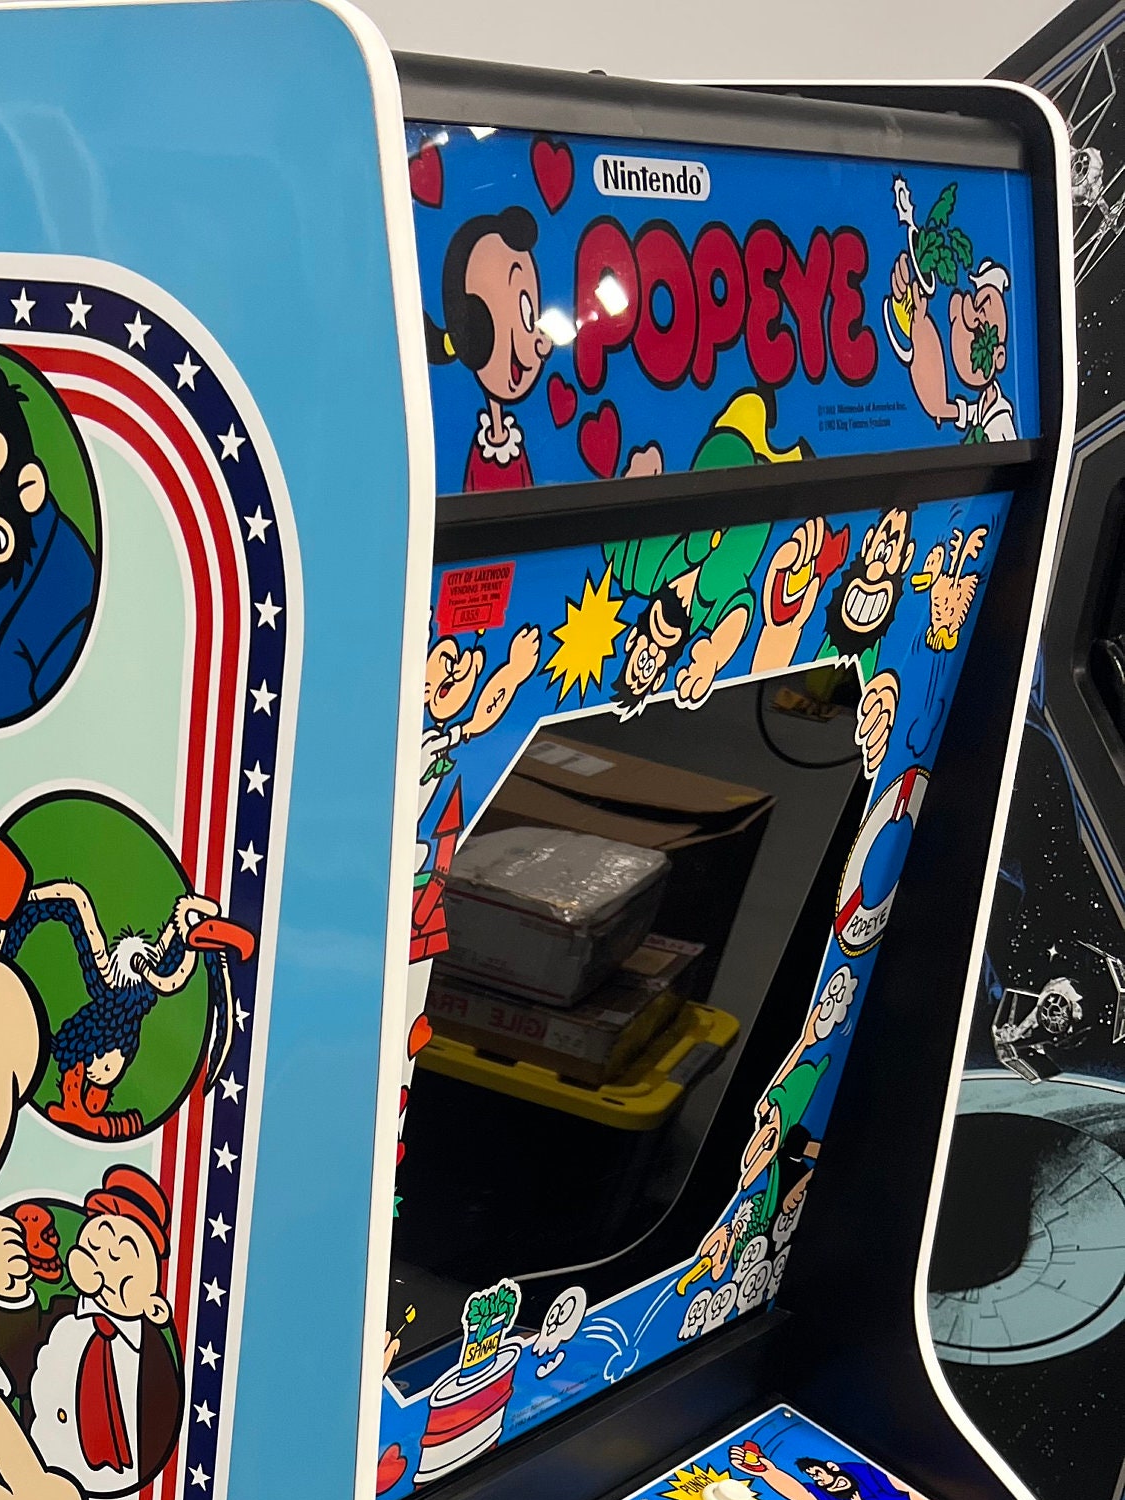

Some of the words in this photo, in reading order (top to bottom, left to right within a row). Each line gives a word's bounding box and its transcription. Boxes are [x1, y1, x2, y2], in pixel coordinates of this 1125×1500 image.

[602, 159, 702, 195] Nintendo
[573, 214, 878, 395] POPEYE
[447, 573, 464, 586] CITY
[464, 572, 473, 582] OF
[474, 567, 510, 582] LAKEWOOD
[451, 584, 478, 596] VENDING
[481, 581, 502, 591] PERMIT
[847, 906, 887, 937] POPEYE
[681, 1473, 714, 1500] PUNCH
